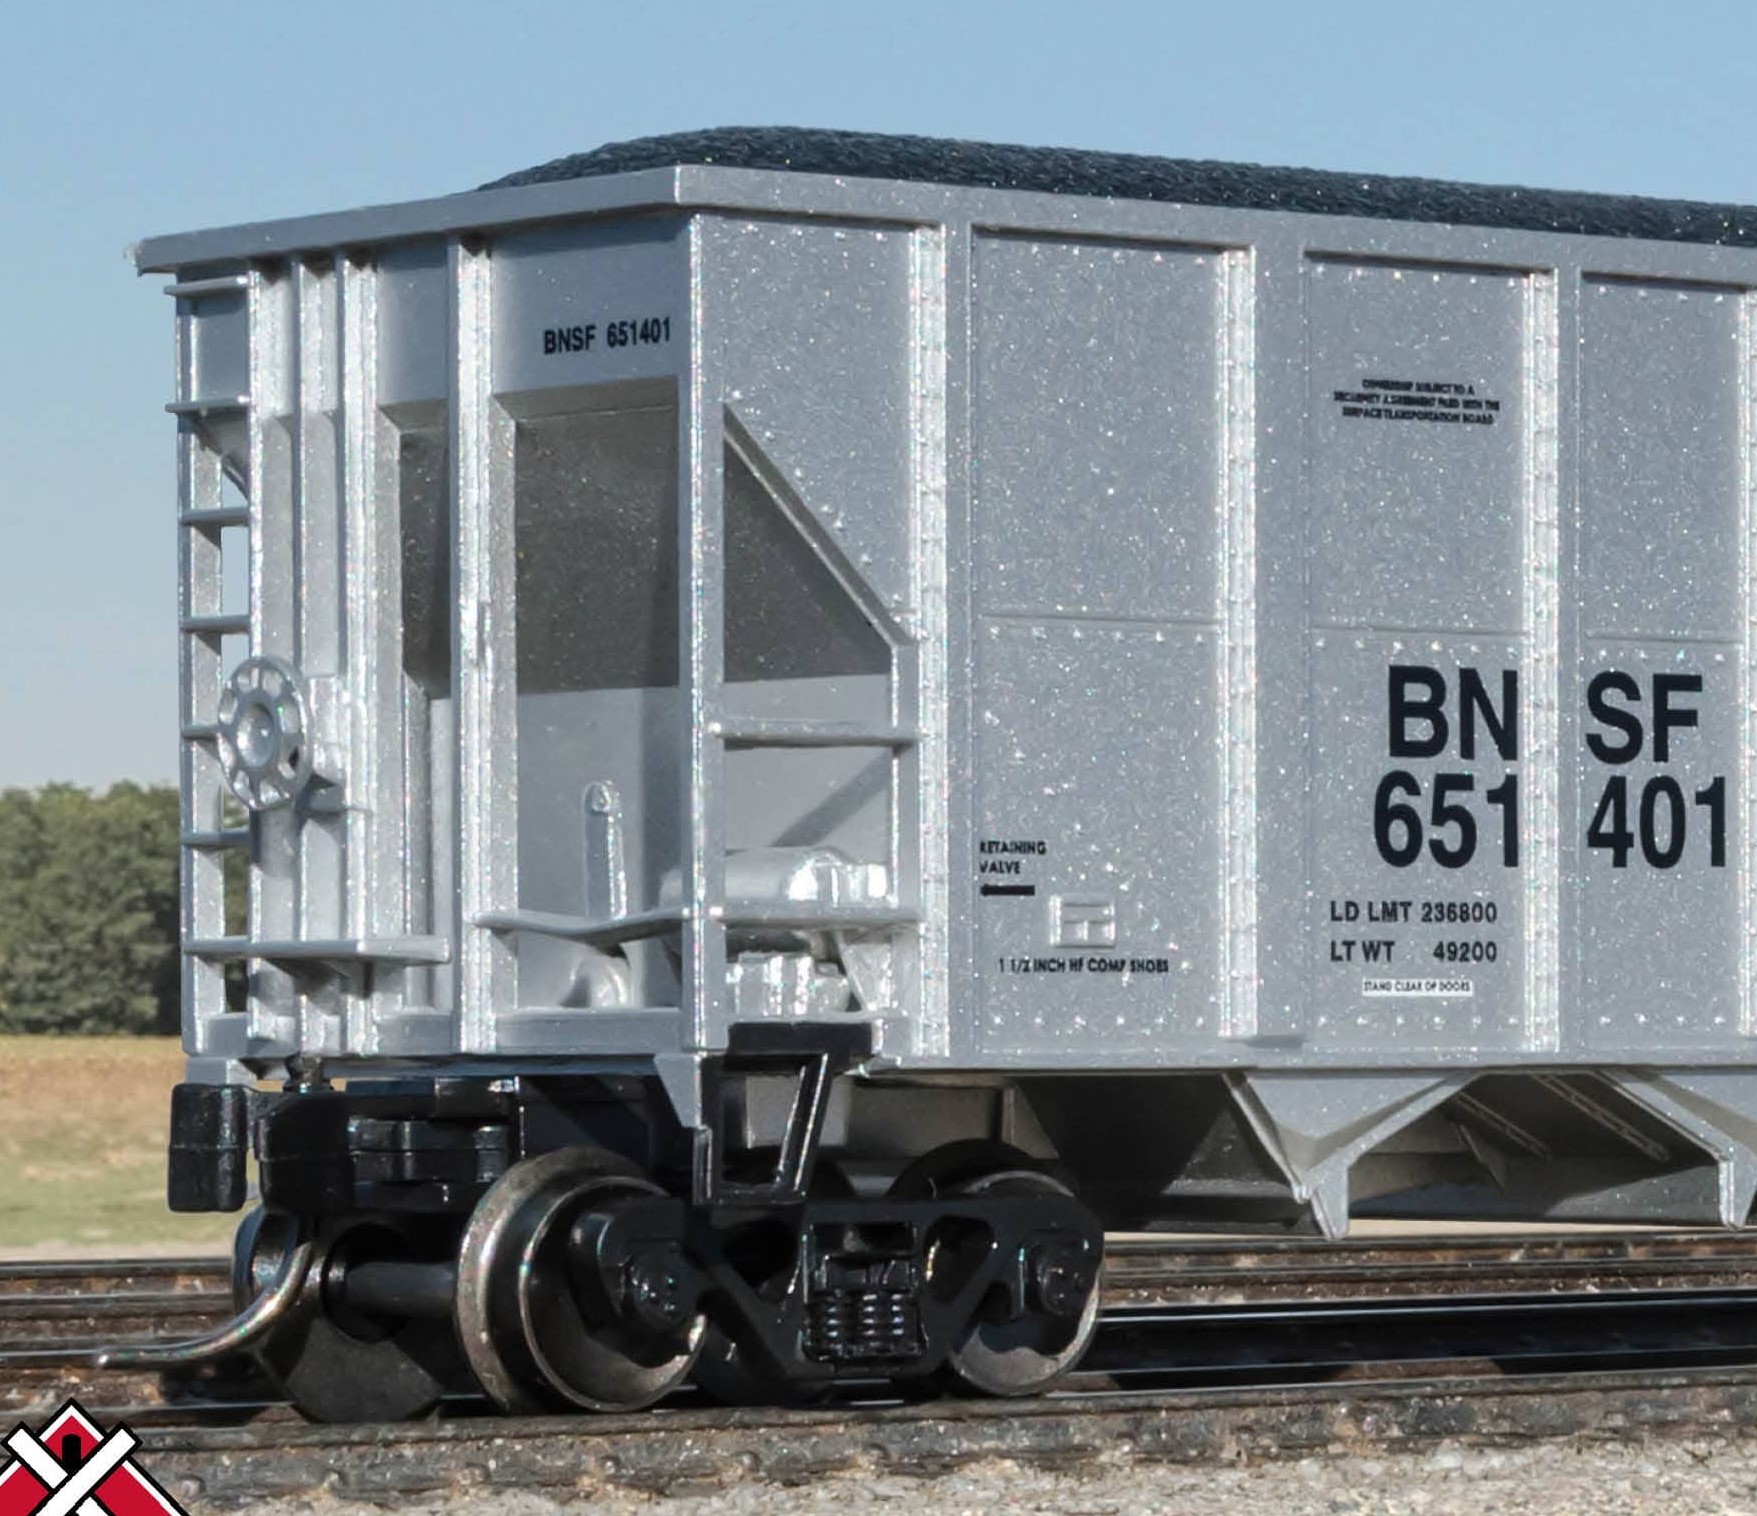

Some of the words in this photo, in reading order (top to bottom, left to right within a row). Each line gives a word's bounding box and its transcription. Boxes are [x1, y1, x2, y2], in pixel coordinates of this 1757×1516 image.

[544, 325, 597, 354] BNSF
[606, 316, 671, 347] 651401
[979, 841, 1046, 854] RETAINING
[979, 861, 1021, 874] VALVE
[1330, 901, 1360, 922] LD
[1368, 901, 1412, 922] LMT
[1421, 902, 1498, 923] 236800
[1330, 941, 1356, 962] LT
[1362, 941, 1395, 962] WT
[1433, 941, 1498, 963] 49200
[1033, 958, 1065, 973] INCH
[1088, 958, 1127, 973] COMP
[1130, 958, 1169, 973] SHOES
